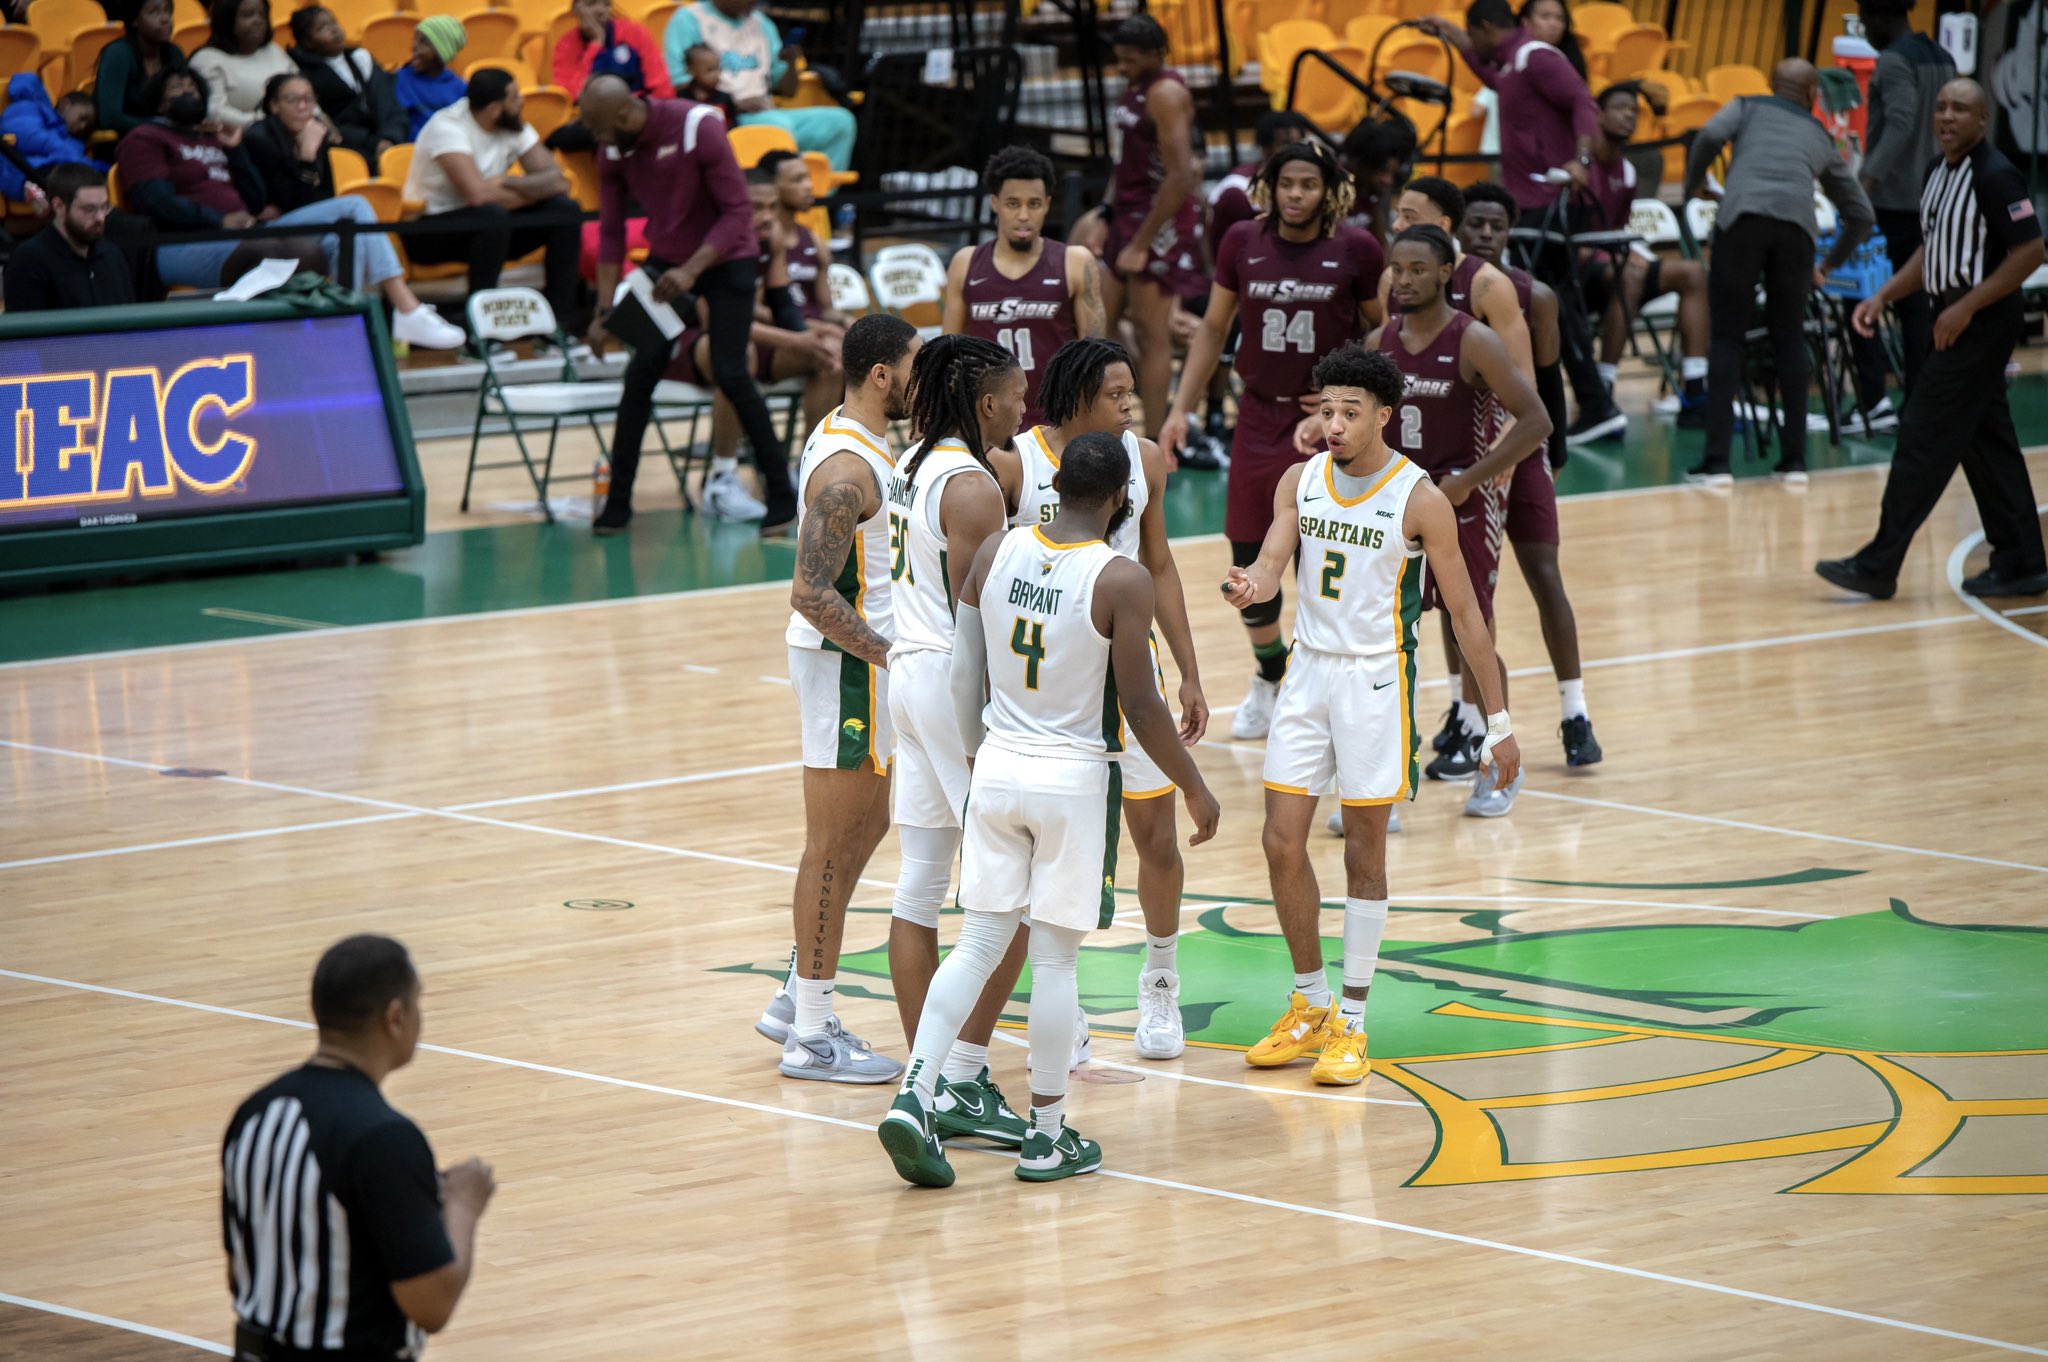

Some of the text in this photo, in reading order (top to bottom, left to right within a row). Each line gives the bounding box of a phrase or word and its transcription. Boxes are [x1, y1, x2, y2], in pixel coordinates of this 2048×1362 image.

[971, 297, 1061, 324] THE SHORE
[1247, 278, 1337, 303] THE SHORE
[997, 328, 1035, 371] 11
[1262, 308, 1315, 353] 24
[0, 354, 257, 508] EAC
[1400, 404, 1423, 450] 2
[1299, 515, 1385, 550] SPARTANS
[1375, 509, 1395, 519] MEAC
[1319, 547, 1348, 602] 2
[1008, 577, 1063, 616] BRYANT
[1009, 615, 1046, 692] 4
